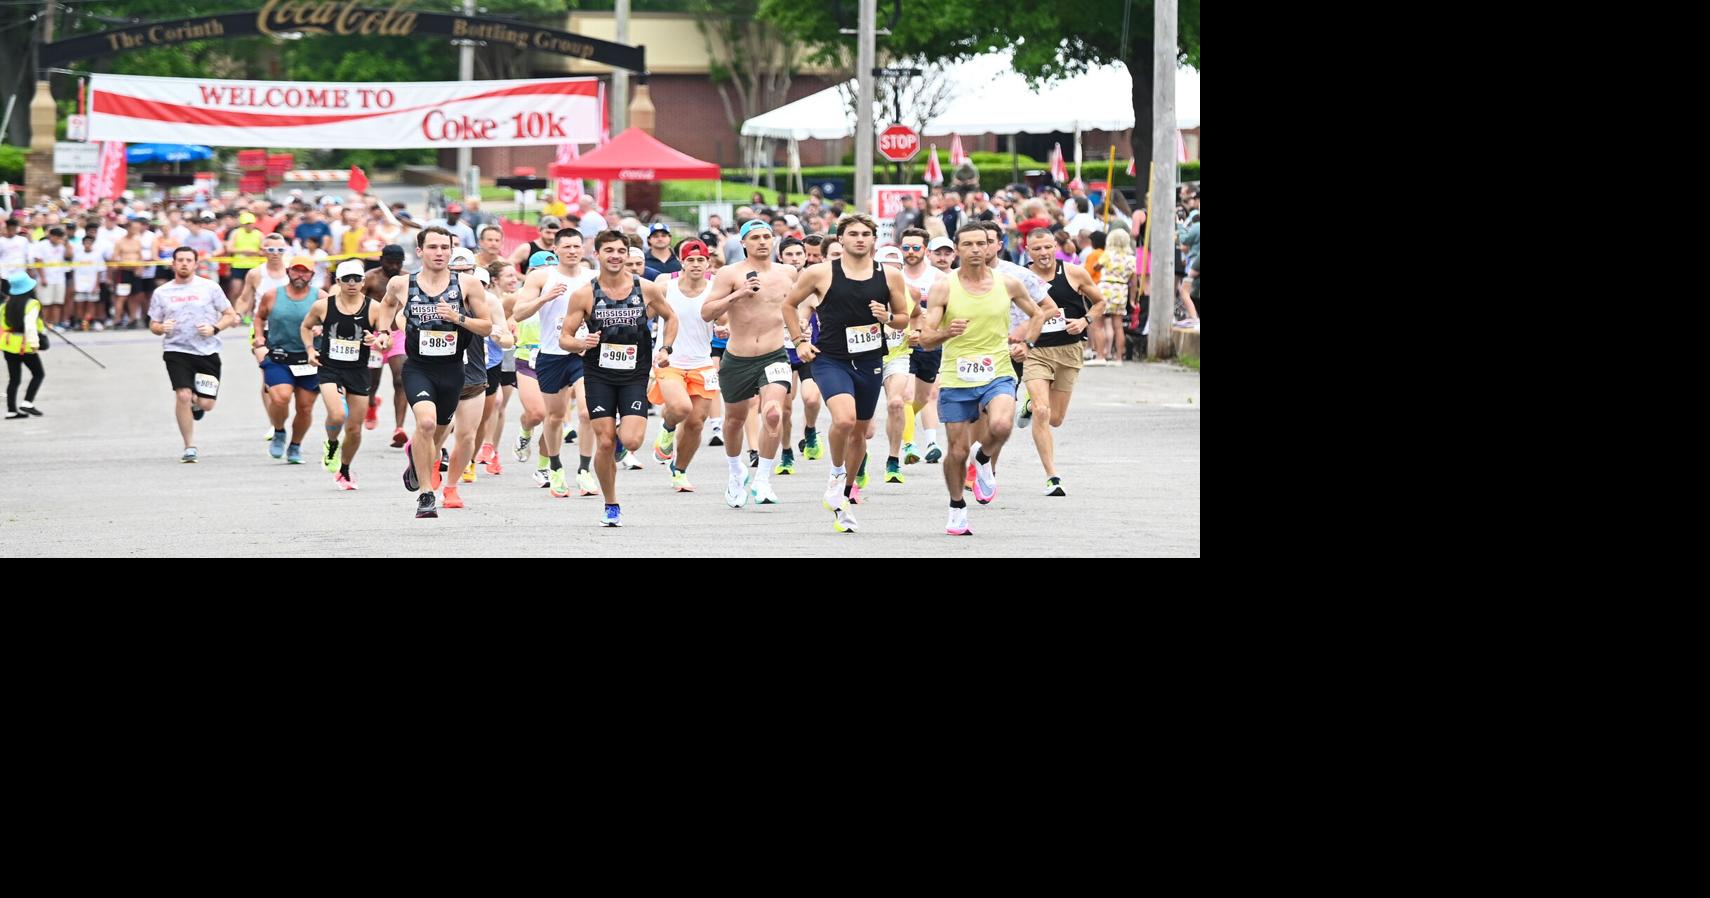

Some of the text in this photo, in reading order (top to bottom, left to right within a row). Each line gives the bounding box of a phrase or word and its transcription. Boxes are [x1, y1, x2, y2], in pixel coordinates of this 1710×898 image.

[106, 19, 224, 51] The Corinth
[453, 18, 594, 58] Bottling Group
[199, 85, 396, 109] WELCOME TO
[422, 109, 567, 141] Coke 10k
[881, 134, 917, 151] STOP
[335, 345, 355, 355] 1186
[966, 362, 985, 373] 784
